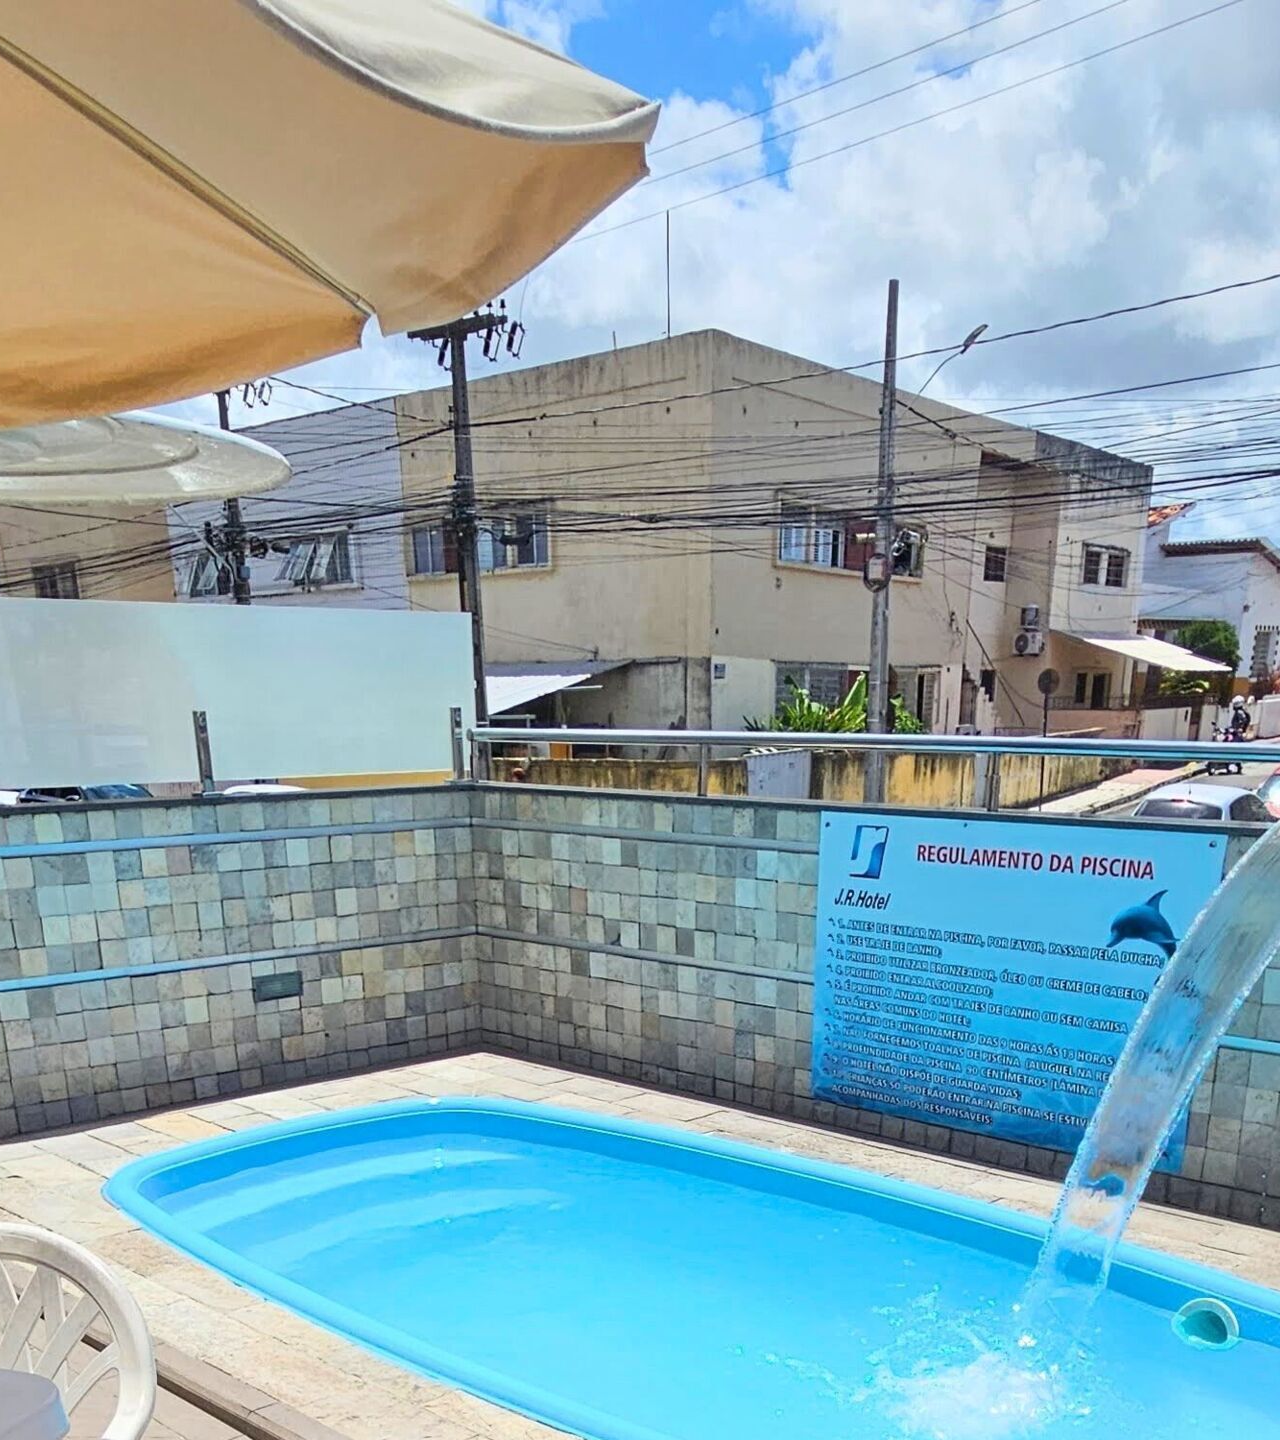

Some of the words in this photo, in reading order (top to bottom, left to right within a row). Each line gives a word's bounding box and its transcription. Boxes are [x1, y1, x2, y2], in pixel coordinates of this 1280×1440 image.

[917, 844, 1043, 871] REGULAMENTO
[1049, 853, 1074, 874] DA
[1080, 856, 1154, 880] PISCINA
[846, 919, 875, 932] ANTES
[876, 922, 889, 934] DE
[890, 924, 927, 939] ENTRAR
[928, 928, 942, 941] NA
[943, 931, 985, 948] PISCINA,
[987, 936, 1009, 949] POR
[1009, 938, 1047, 954] FAVOR,
[1048, 942, 1088, 959] PASSAR
[1090, 947, 1119, 962] PELA
[846, 934, 863, 946] USE
[892, 940, 905, 952] DE
[844, 965, 886, 981] PROIBIDO
[887, 972, 924, 985] ENTRAR
[845, 950, 887, 966] PROIBIDO
[889, 956, 928, 972] UTILIZAR
[999, 969, 1026, 985] ÓLEO
[1028, 975, 1044, 987] OU
[1046, 977, 1083, 993] CREME
[1084, 981, 1100, 995] DE
[834, 994, 852, 1006] NAS
[853, 995, 880, 1011] ÁREAS
[882, 1002, 920, 1018] COMUNS
[922, 1009, 937, 1020] DO
[844, 979, 851, 991] É
[851, 982, 893, 998] PROIBIDO
[893, 989, 926, 1003] ANDAR
[928, 994, 950, 1007] COM
[952, 997, 986, 1013] TRAJES
[987, 1003, 1002, 1015] DE
[1004, 1005, 1040, 1021] BANHO
[1041, 1011, 1058, 1024] OU
[1060, 1013, 1083, 1027] SEM
[1084, 1017, 1128, 1034] CAMISA
[842, 1011, 881, 1026] HORÁRIO
[882, 1018, 896, 1029] DE
[896, 1020, 977, 1043] FUNCIONAMENTO
[978, 1034, 999, 1047] DAS
[1009, 1040, 1043, 1055] HORAS
[862, 1029, 921, 1048] FORNECEMOS
[923, 1041, 964, 1057] TOALHAS
[966, 1048, 980, 1060] DE
[981, 1051, 1020, 1068] PISCINA
[1077, 1067, 1093, 1080] NA
[841, 1056, 849, 1065] O
[850, 1058, 877, 1070] HOTEL
[878, 1062, 897, 1075] NÃO
[933, 1074, 946, 1084] DE
[948, 1077, 987, 1093] GUARDA
[842, 1041, 909, 1062] PROFUNDIDADE
[910, 1054, 924, 1064] DA
[926, 1058, 962, 1073] PISCINA
[980, 1067, 1047, 1087] CENTÍMETROS
[831, 1084, 901, 1105] ACOMPANHADAS
[903, 1099, 922, 1110] DOS
[847, 1071, 887, 1088] CRIANÇAS
[903, 1083, 945, 1100] PODERÃO
[947, 1092, 984, 1107] ENTRAR
[985, 1099, 1000, 1110] NA
[1002, 1102, 1040, 1119] PISCINA
[1042, 1111, 1056, 1122] SE
[1057, 1112, 1088, 1128] ESTIV
